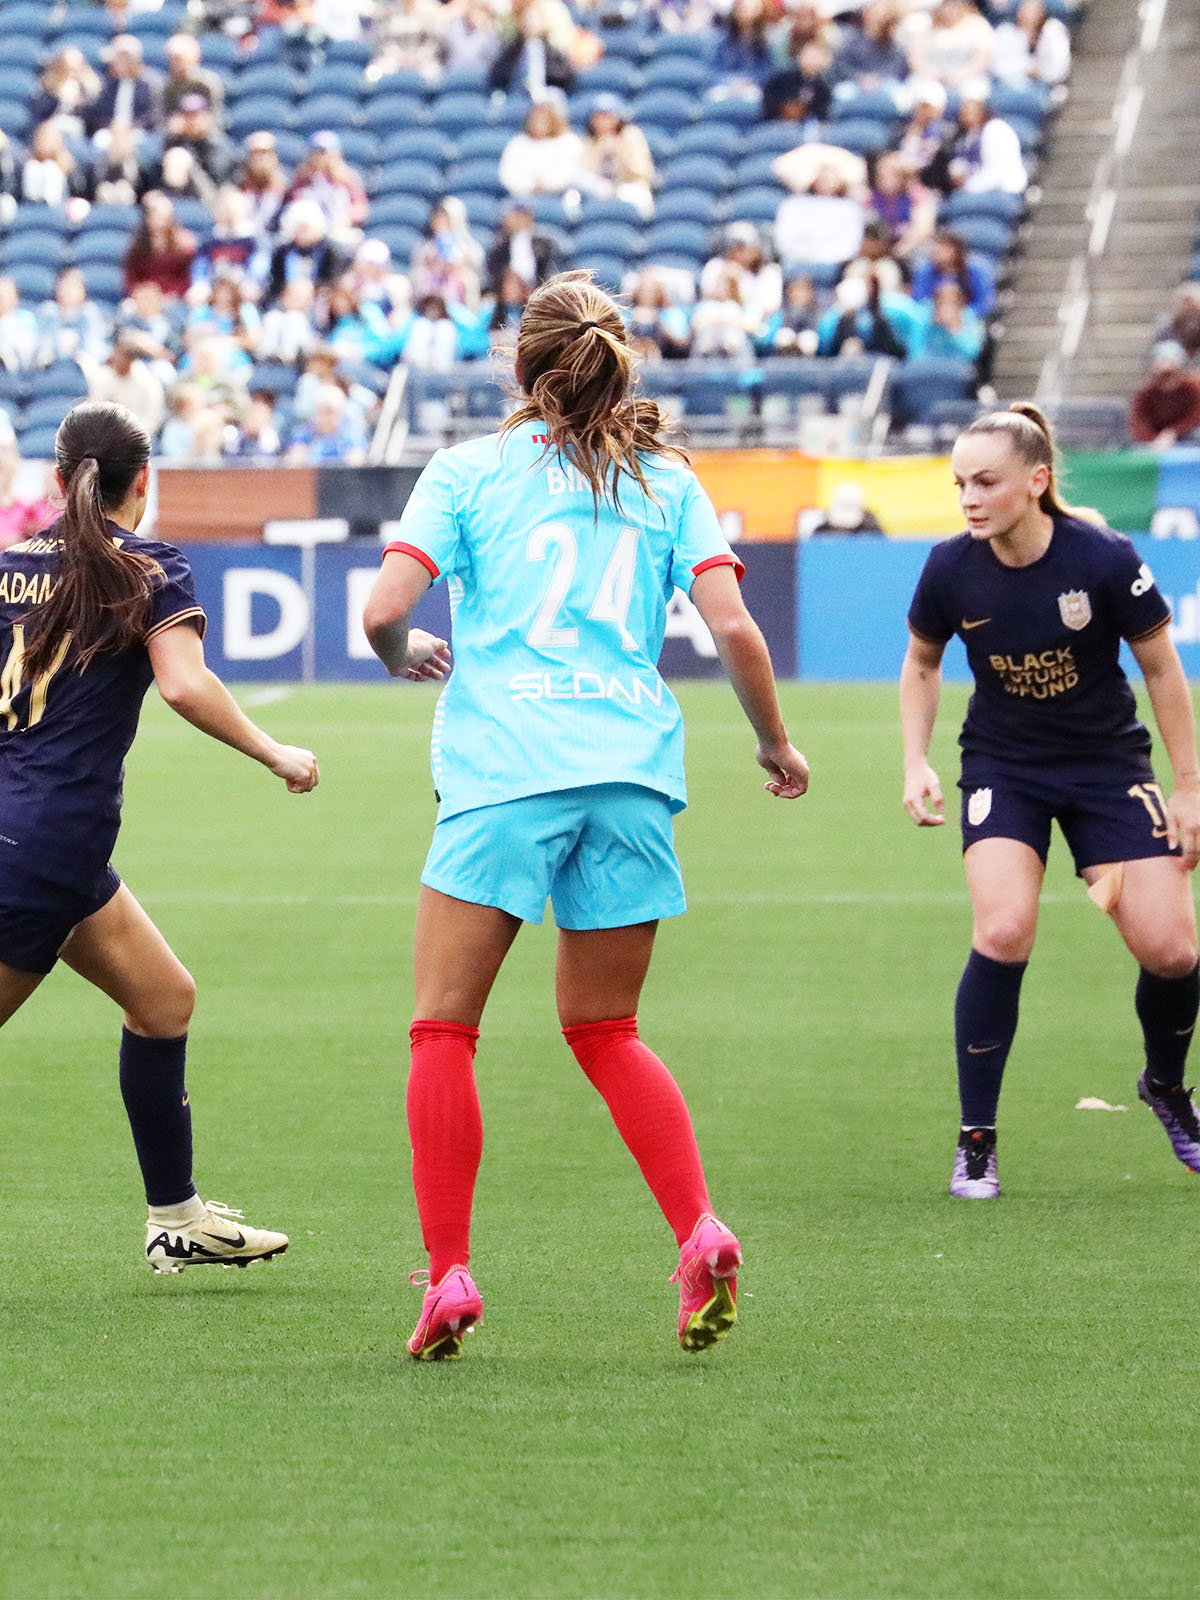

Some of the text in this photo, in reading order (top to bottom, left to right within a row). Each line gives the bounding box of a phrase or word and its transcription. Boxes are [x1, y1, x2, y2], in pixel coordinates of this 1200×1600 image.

[525, 521, 641, 650] 24
[989, 646, 1073, 671] BLACK
[1000, 662, 1076, 685] UTURE
